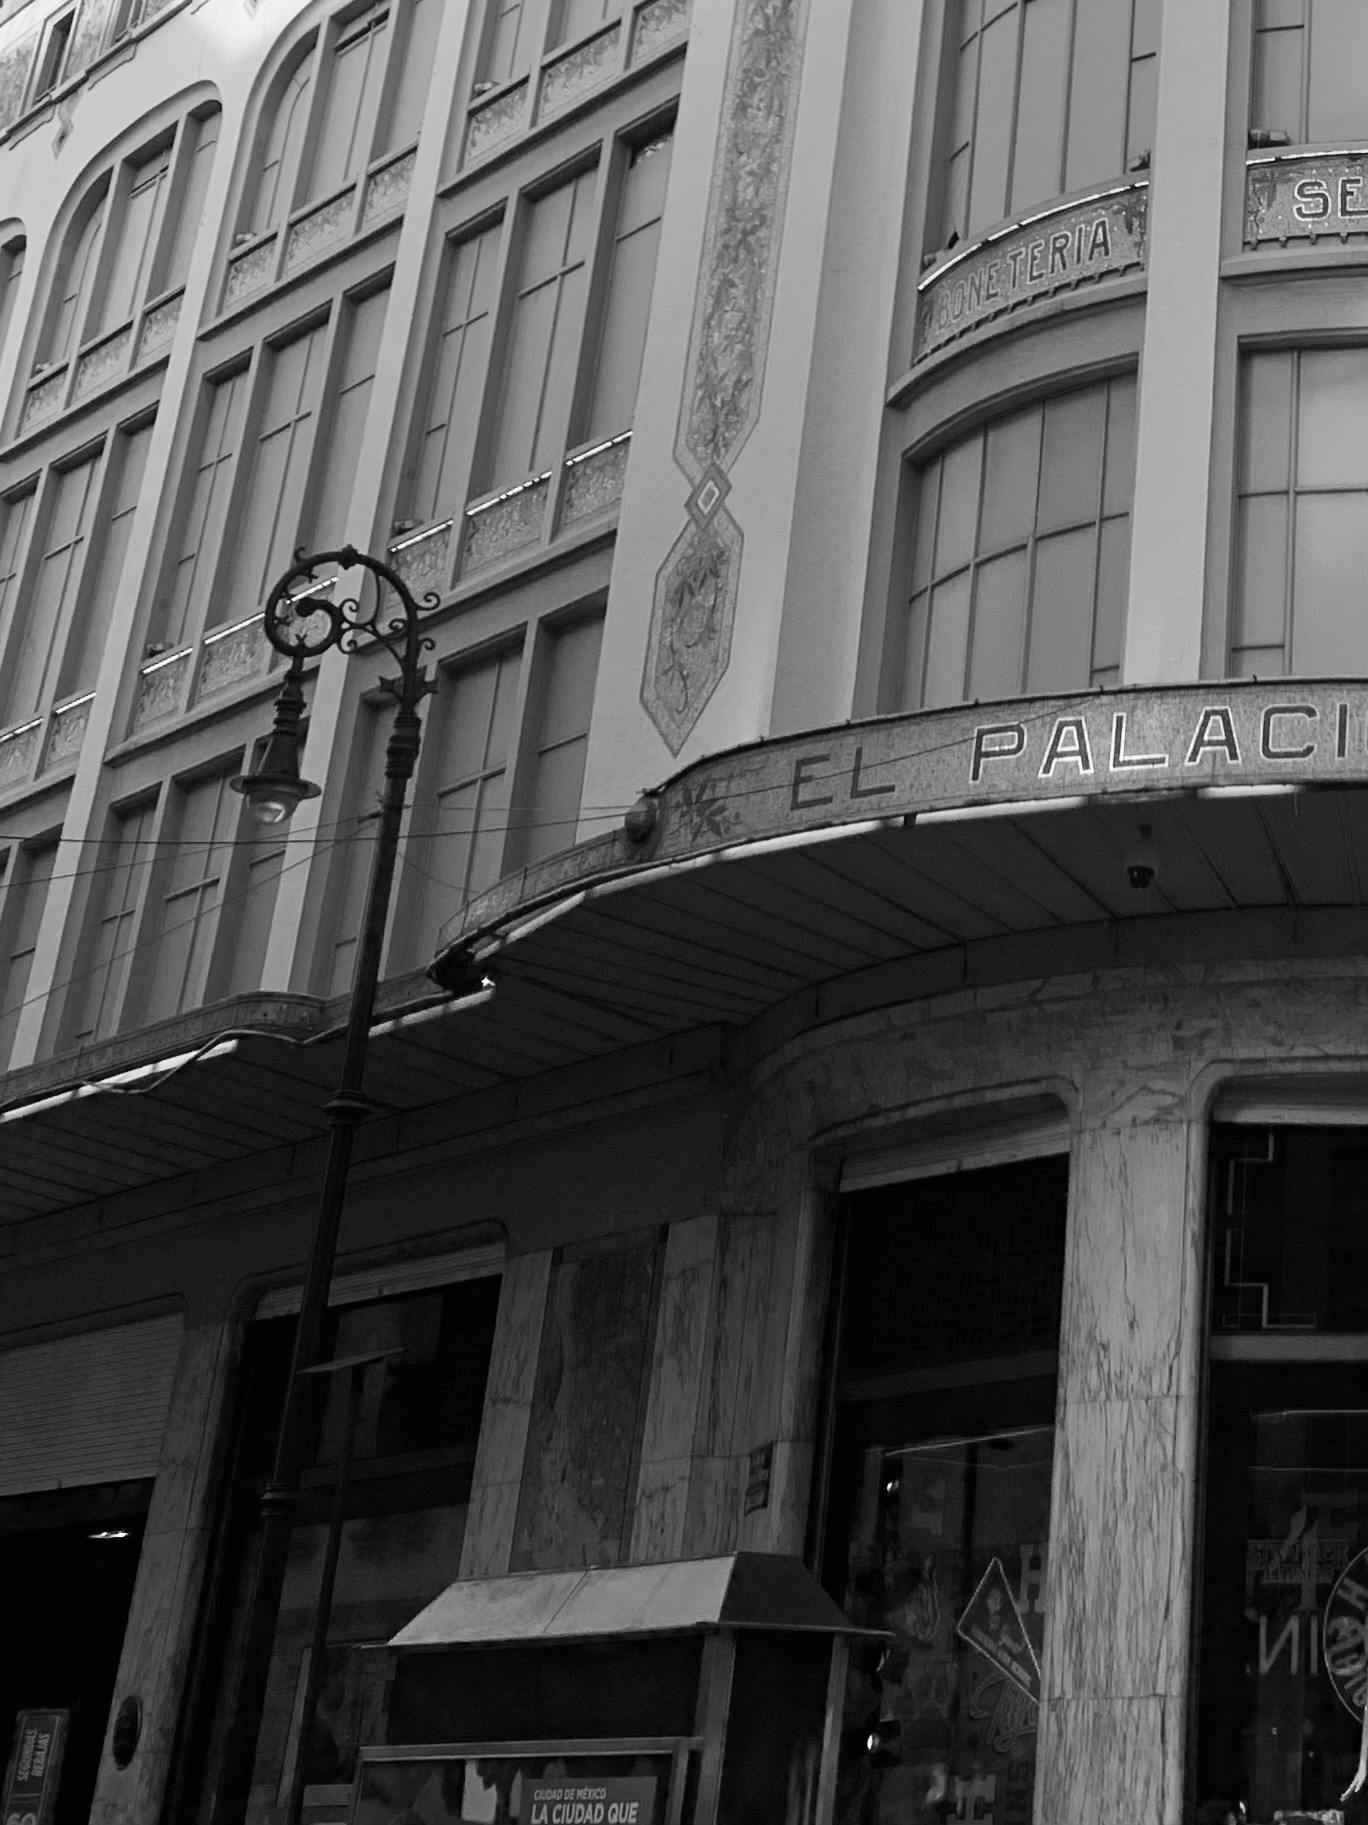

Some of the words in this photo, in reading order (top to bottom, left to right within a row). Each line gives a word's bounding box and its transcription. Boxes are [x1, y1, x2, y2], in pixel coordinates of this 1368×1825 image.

[936, 217, 1113, 333] BONETERIA
[790, 745, 896, 812] EL
[531, 1803, 548, 1825] LA
[552, 1803, 605, 1825] CIUDAD
[607, 1801, 640, 1824] QUE
[534, 1788, 563, 1801] CIUDAD
[564, 1788, 575, 1800] DE
[576, 1785, 607, 1800] MÉXICO
